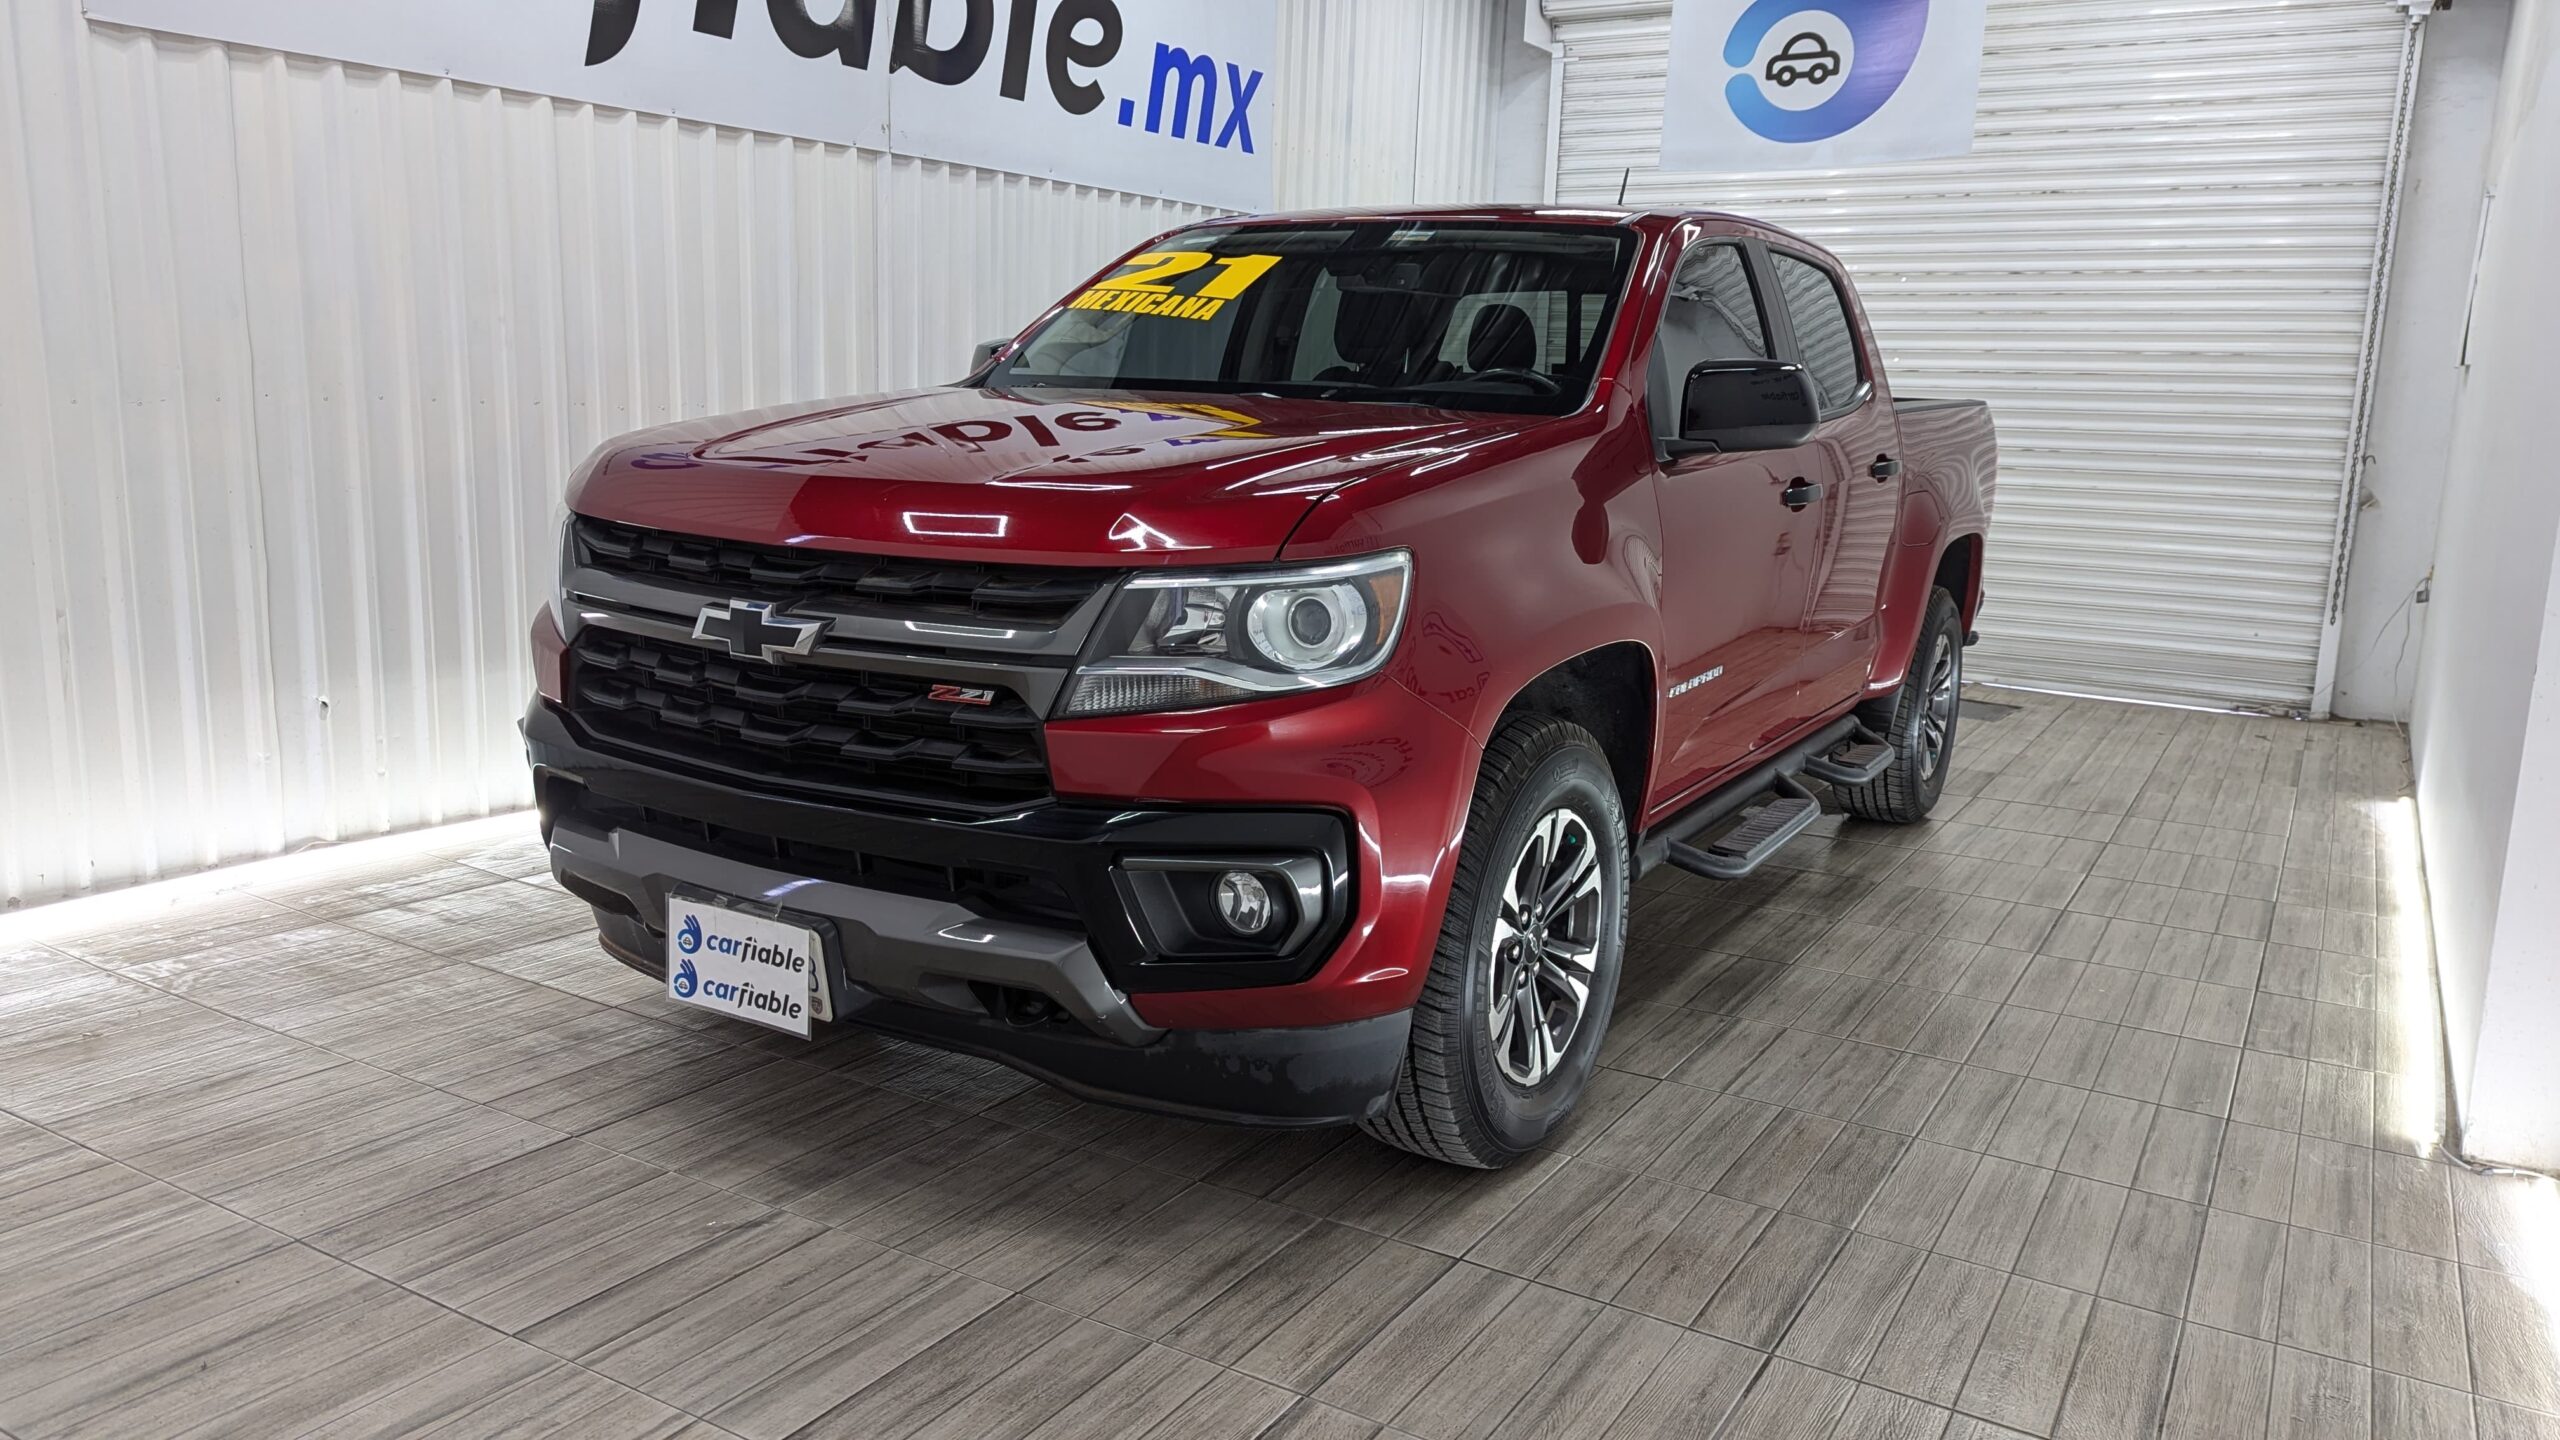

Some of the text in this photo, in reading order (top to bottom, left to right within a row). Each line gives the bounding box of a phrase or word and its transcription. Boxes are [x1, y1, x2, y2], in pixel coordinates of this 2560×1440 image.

[1092, 250, 1283, 300] 21
[1067, 290, 1226, 321] MEXICANA
[928, 684, 995, 706] Z71
[1668, 665, 1724, 699] COLORADO
[706, 934, 806, 973] carfiable
[703, 979, 802, 1020] carfiable
